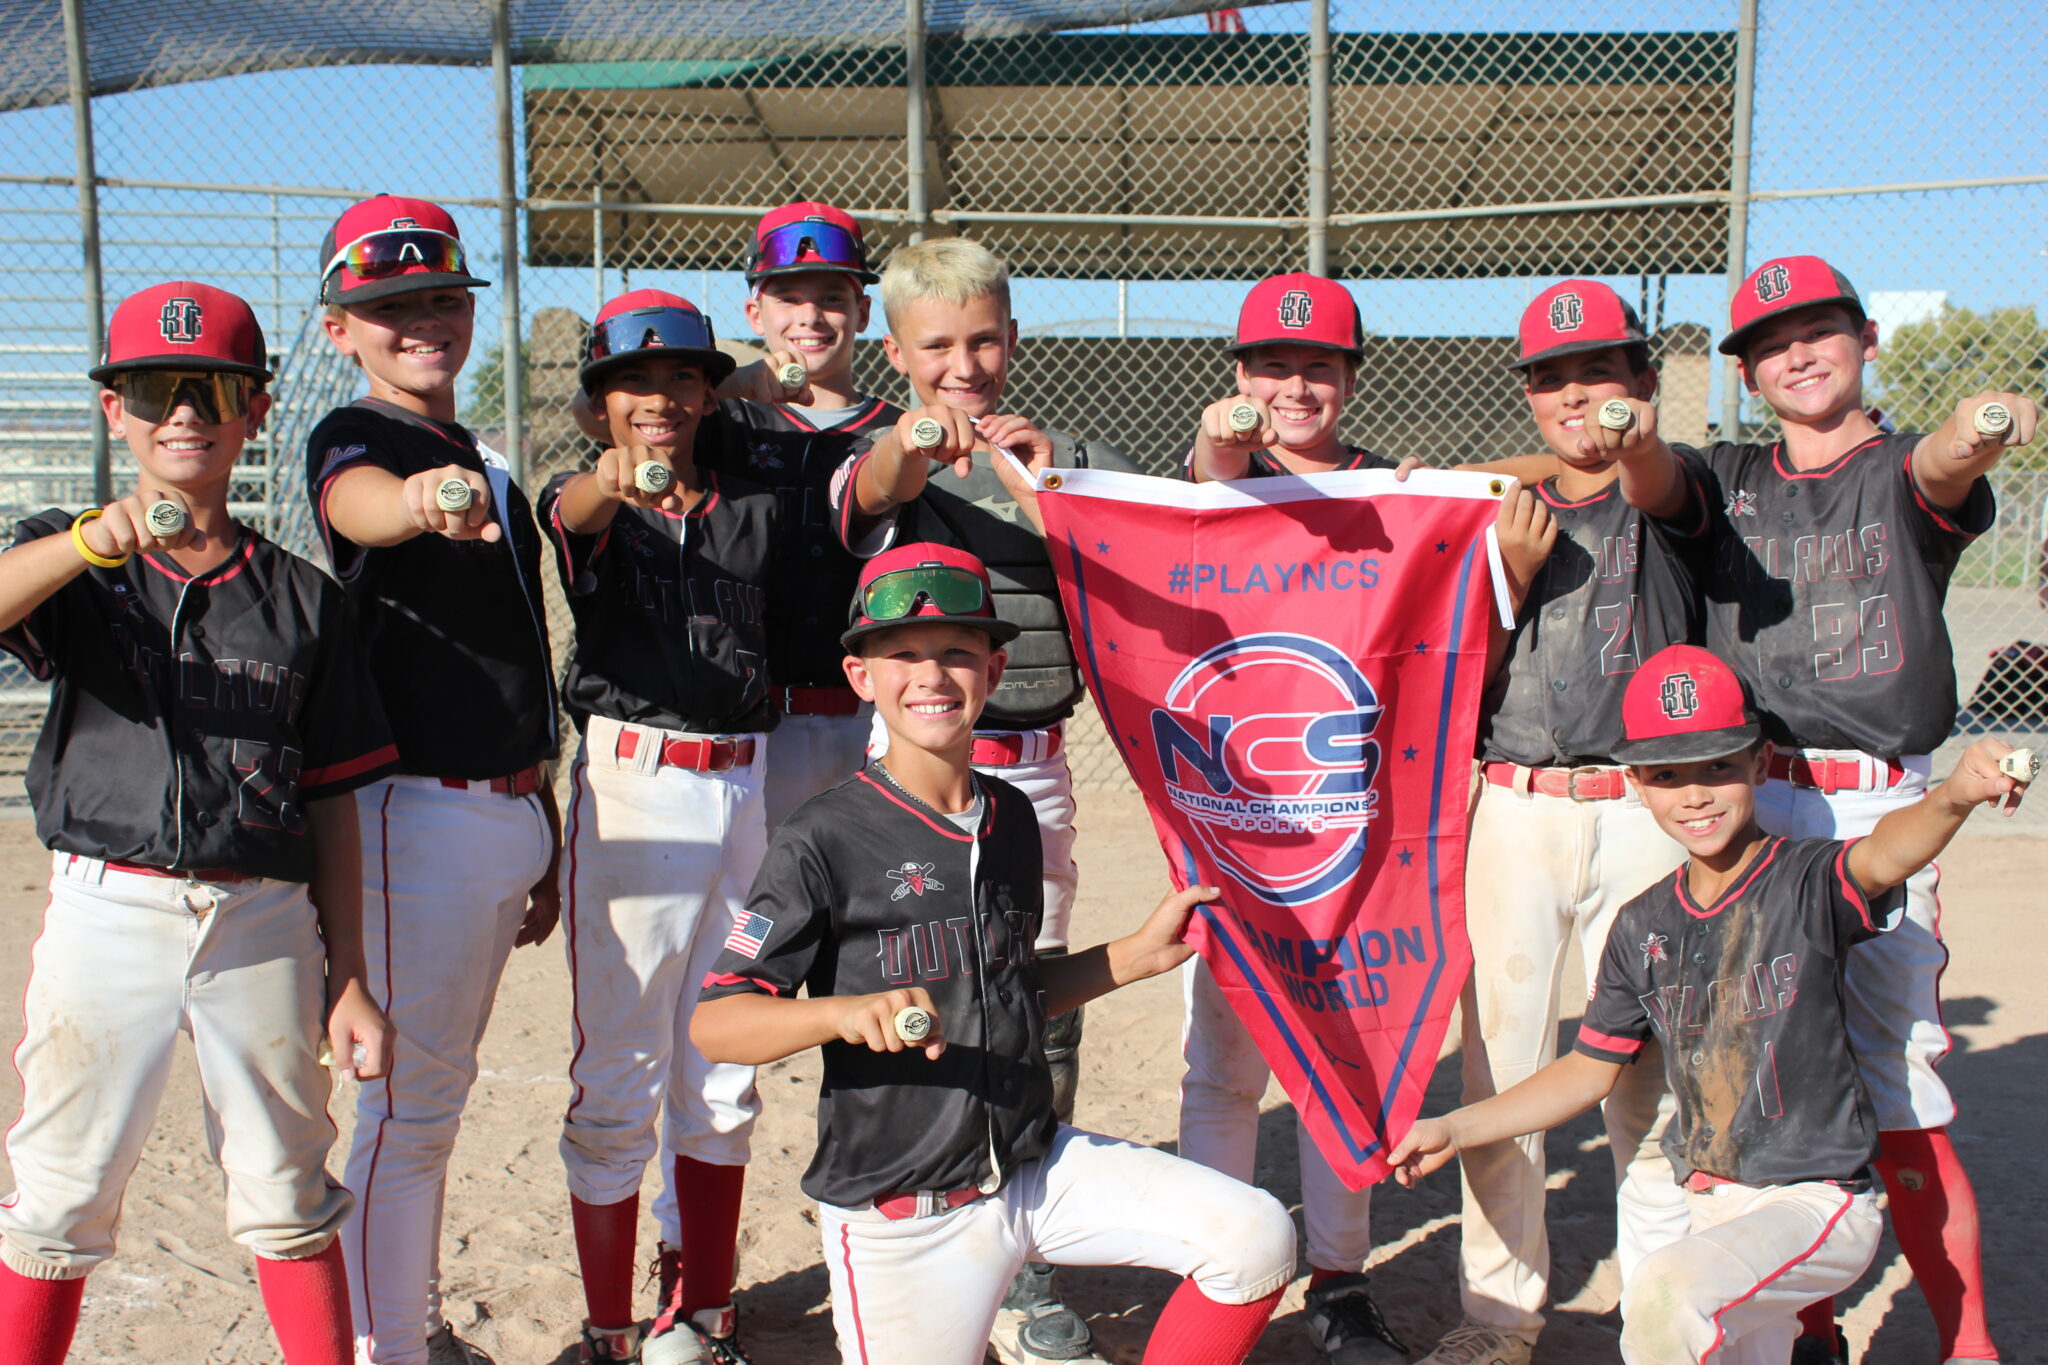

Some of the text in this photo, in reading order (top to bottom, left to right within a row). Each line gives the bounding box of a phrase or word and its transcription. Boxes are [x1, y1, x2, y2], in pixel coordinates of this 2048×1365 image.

[646, 471, 667, 480] NCS
[153, 508, 179, 522] NCS
[1168, 558, 1380, 594] #PLAYNCS
[1812, 593, 1905, 682] 99
[1150, 705, 1386, 799] NCS
[1167, 785, 1247, 814] NATIONAL
[1229, 817, 1324, 832] SPORTS
[1243, 926, 1427, 978] AMPION
[1279, 972, 1390, 1013] WORLD
[904, 1016, 928, 1032] NCS
